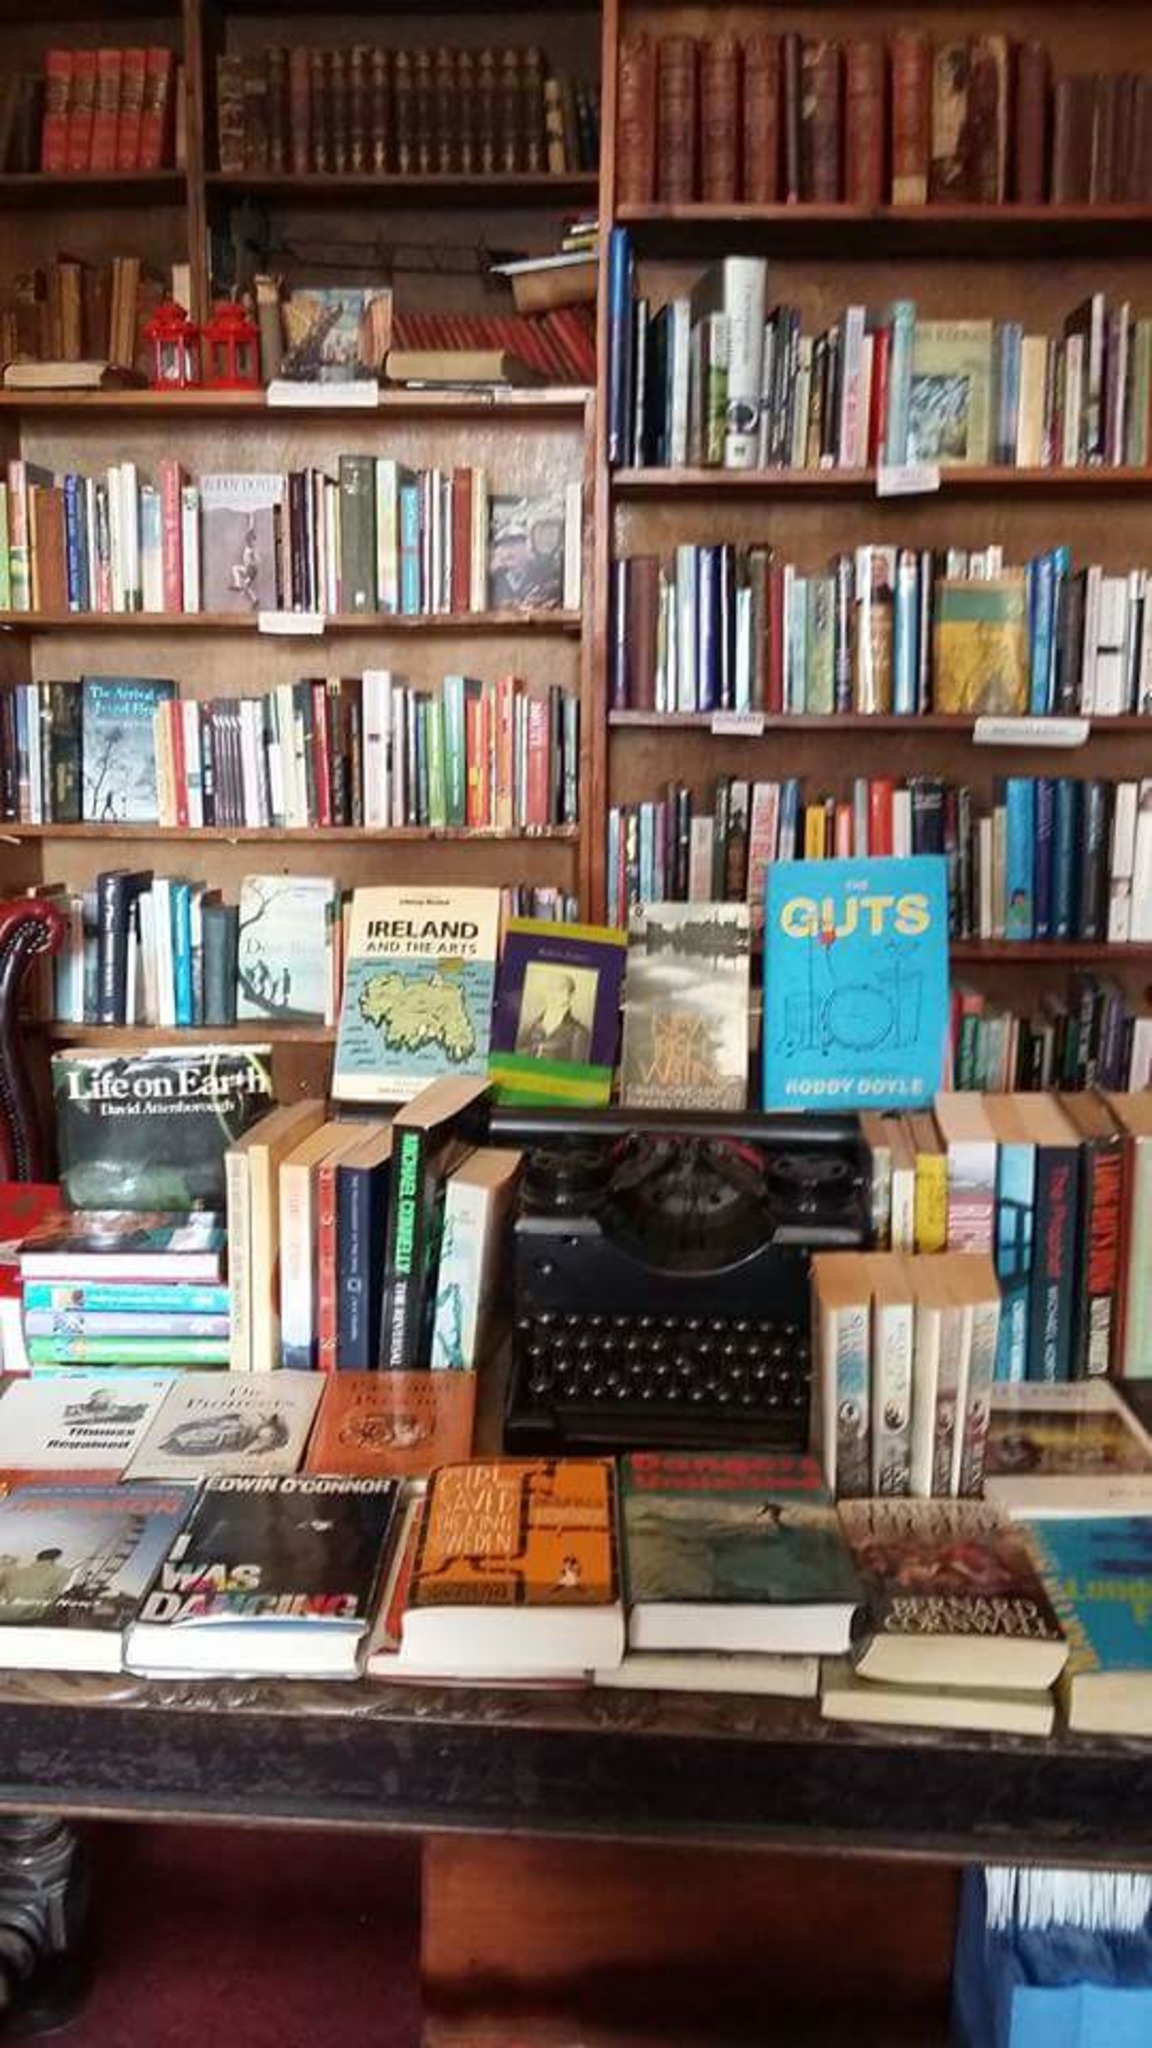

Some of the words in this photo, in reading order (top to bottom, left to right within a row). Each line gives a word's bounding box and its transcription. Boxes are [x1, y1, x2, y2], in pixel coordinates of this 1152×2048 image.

[845, 879, 869, 891] THE
[780, 894, 931, 938] GUTS
[367, 920, 479, 940] IRELAND
[366, 940, 400, 953] AND
[406, 941, 435, 953] THE
[436, 942, 477, 955] ARTS
[66, 1070, 130, 1100] Life
[132, 1077, 175, 1099] on
[178, 1066, 268, 1096] Earth
[785, 1077, 855, 1096] RODDY
[857, 1077, 924, 1096] DOYLE
[101, 1101, 141, 1117] David
[143, 1099, 235, 1116] Attenborough
[205, 1477, 278, 1492] EDWIN
[280, 1478, 391, 1494] O'CONNOR
[169, 1533, 192, 1561] I
[162, 1562, 263, 1594] WAS
[139, 1590, 358, 1623] DANCING
[891, 1596, 1038, 1616] BERNARD
[884, 1614, 1059, 1640] CORNWELL
